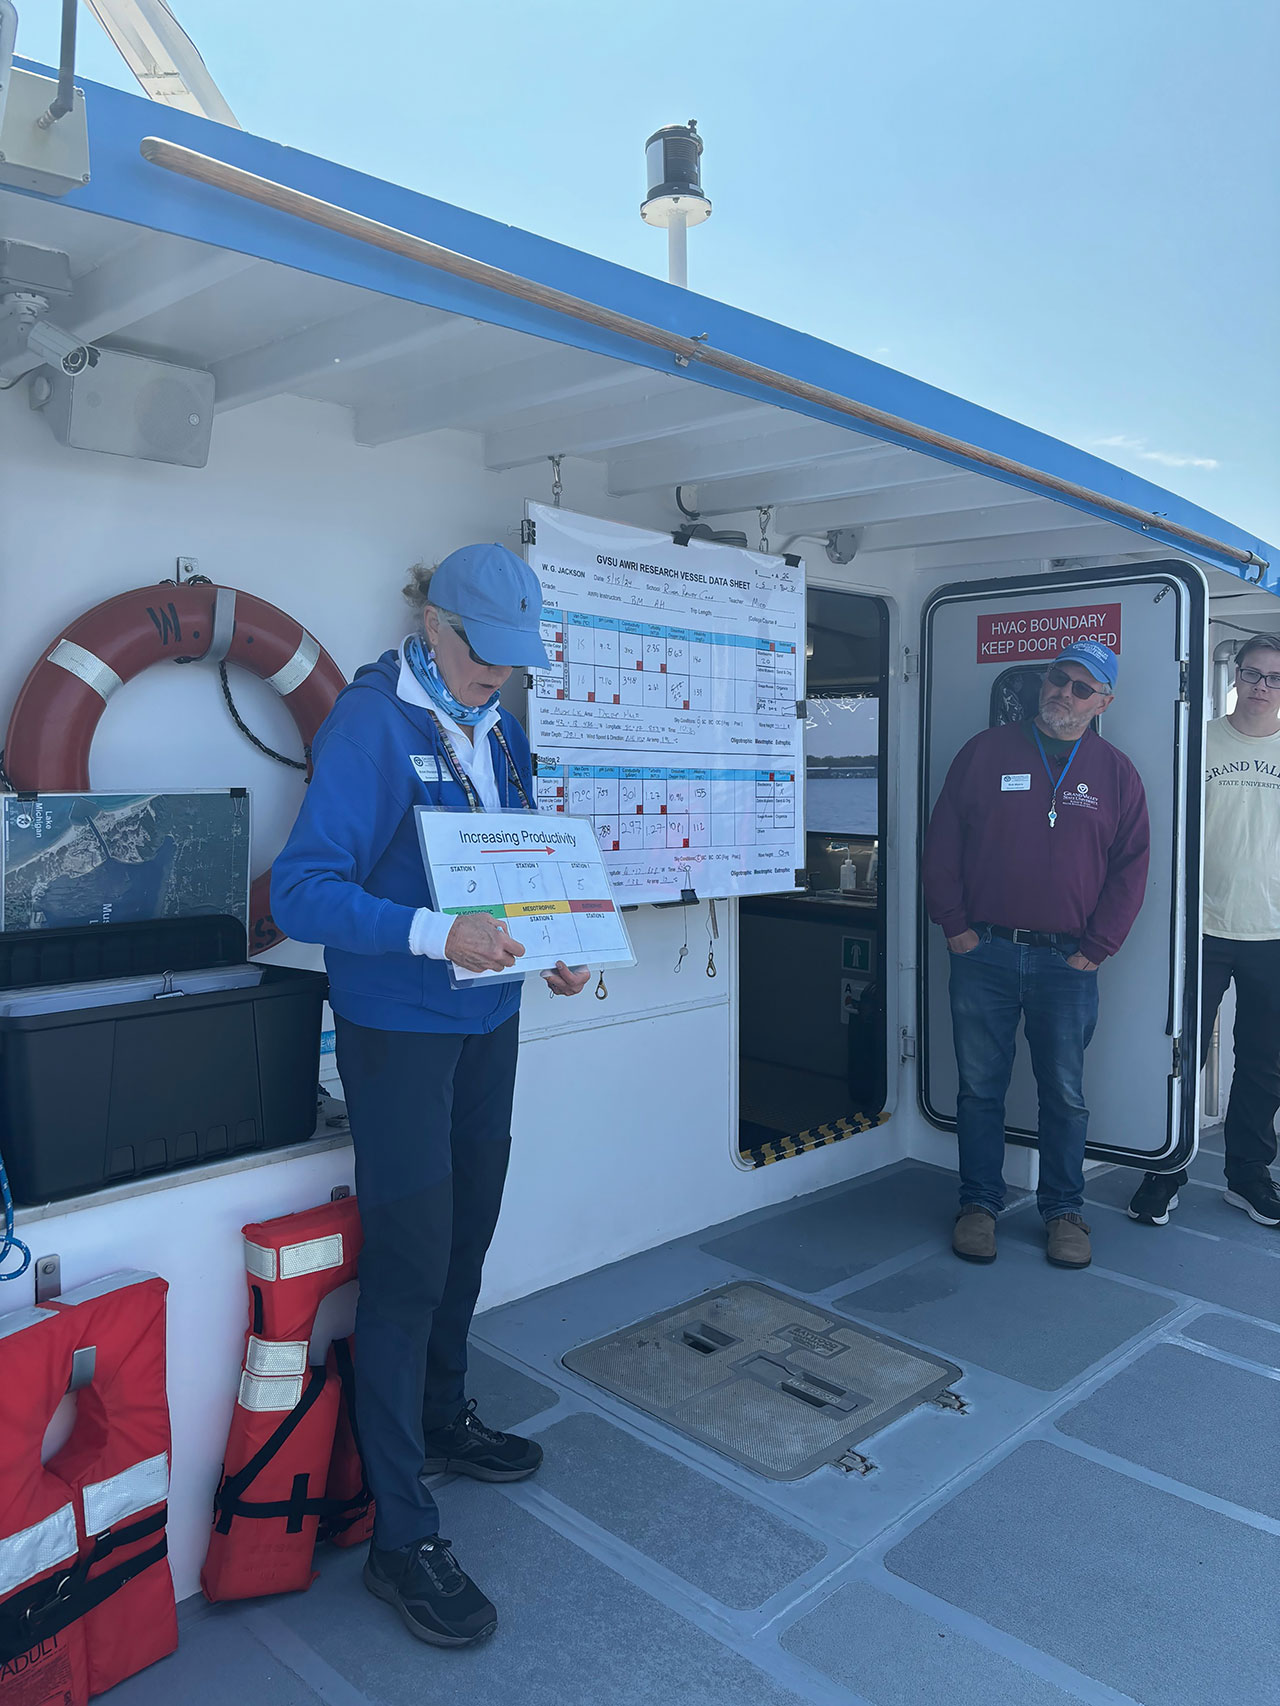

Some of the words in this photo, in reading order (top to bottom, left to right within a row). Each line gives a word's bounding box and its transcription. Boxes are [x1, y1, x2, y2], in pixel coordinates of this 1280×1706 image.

[542, 563, 550, 571] W.
[558, 566, 586, 578] JACKSON
[596, 554, 618, 568] GVSU
[618, 559, 639, 572] AWRI
[640, 563, 679, 580] RESEARCH
[679, 571, 708, 584] VESSEL
[708, 576, 729, 586] DATA
[729, 580, 750, 590] SHEET
[991, 619, 1027, 636] HVAC
[1030, 612, 1107, 632] BOUNDARY
[981, 640, 1014, 655] KEEP
[1018, 637, 1057, 652] DOOR
[1205, 761, 1250, 782] GRAND
[35, 802, 43, 838] Michigan
[459, 830, 520, 846] Increasing
[520, 830, 576, 848] Productivity
[528, 874, 540, 889] 5
[576, 878, 584, 890] 5
[522, 904, 556, 912] MESOTROPHIC
